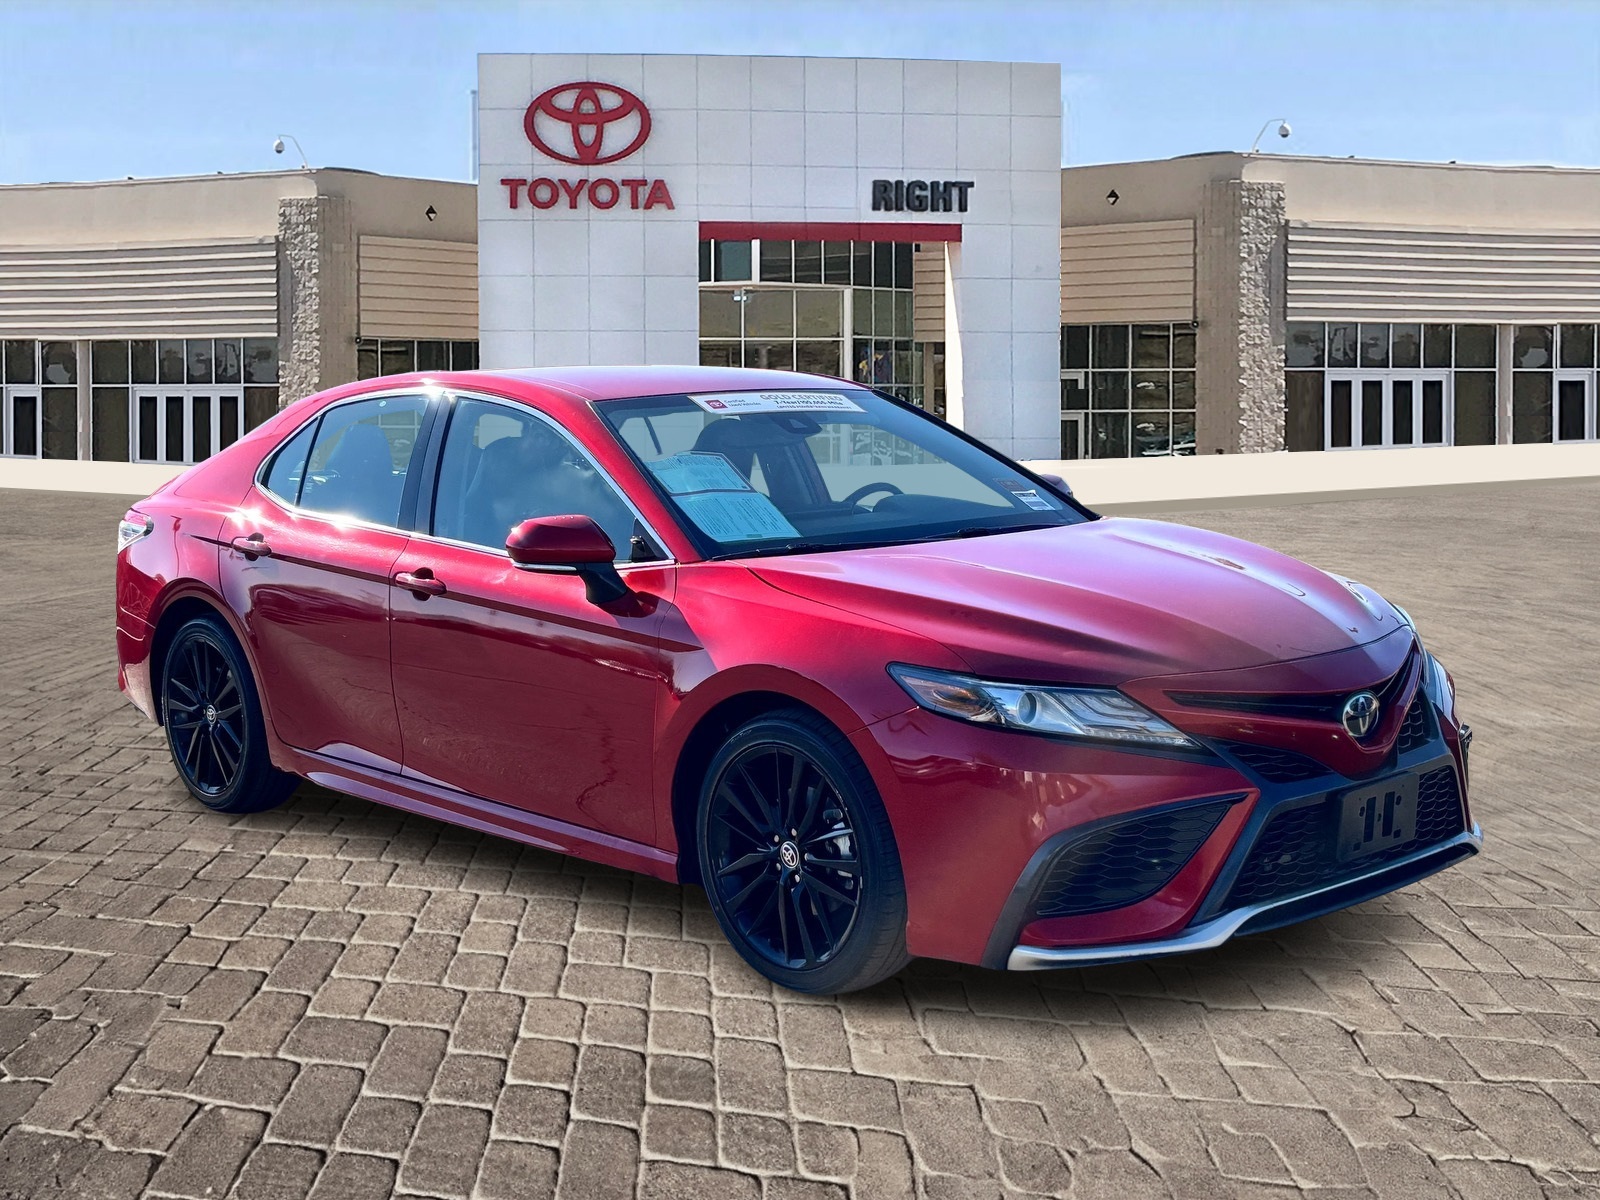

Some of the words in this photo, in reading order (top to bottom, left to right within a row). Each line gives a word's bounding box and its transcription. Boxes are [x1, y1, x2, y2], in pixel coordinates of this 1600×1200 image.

[500, 178, 675, 210] TOYOTA
[872, 180, 974, 212] RIGHT
[791, 394, 843, 402] CERTIFIED
